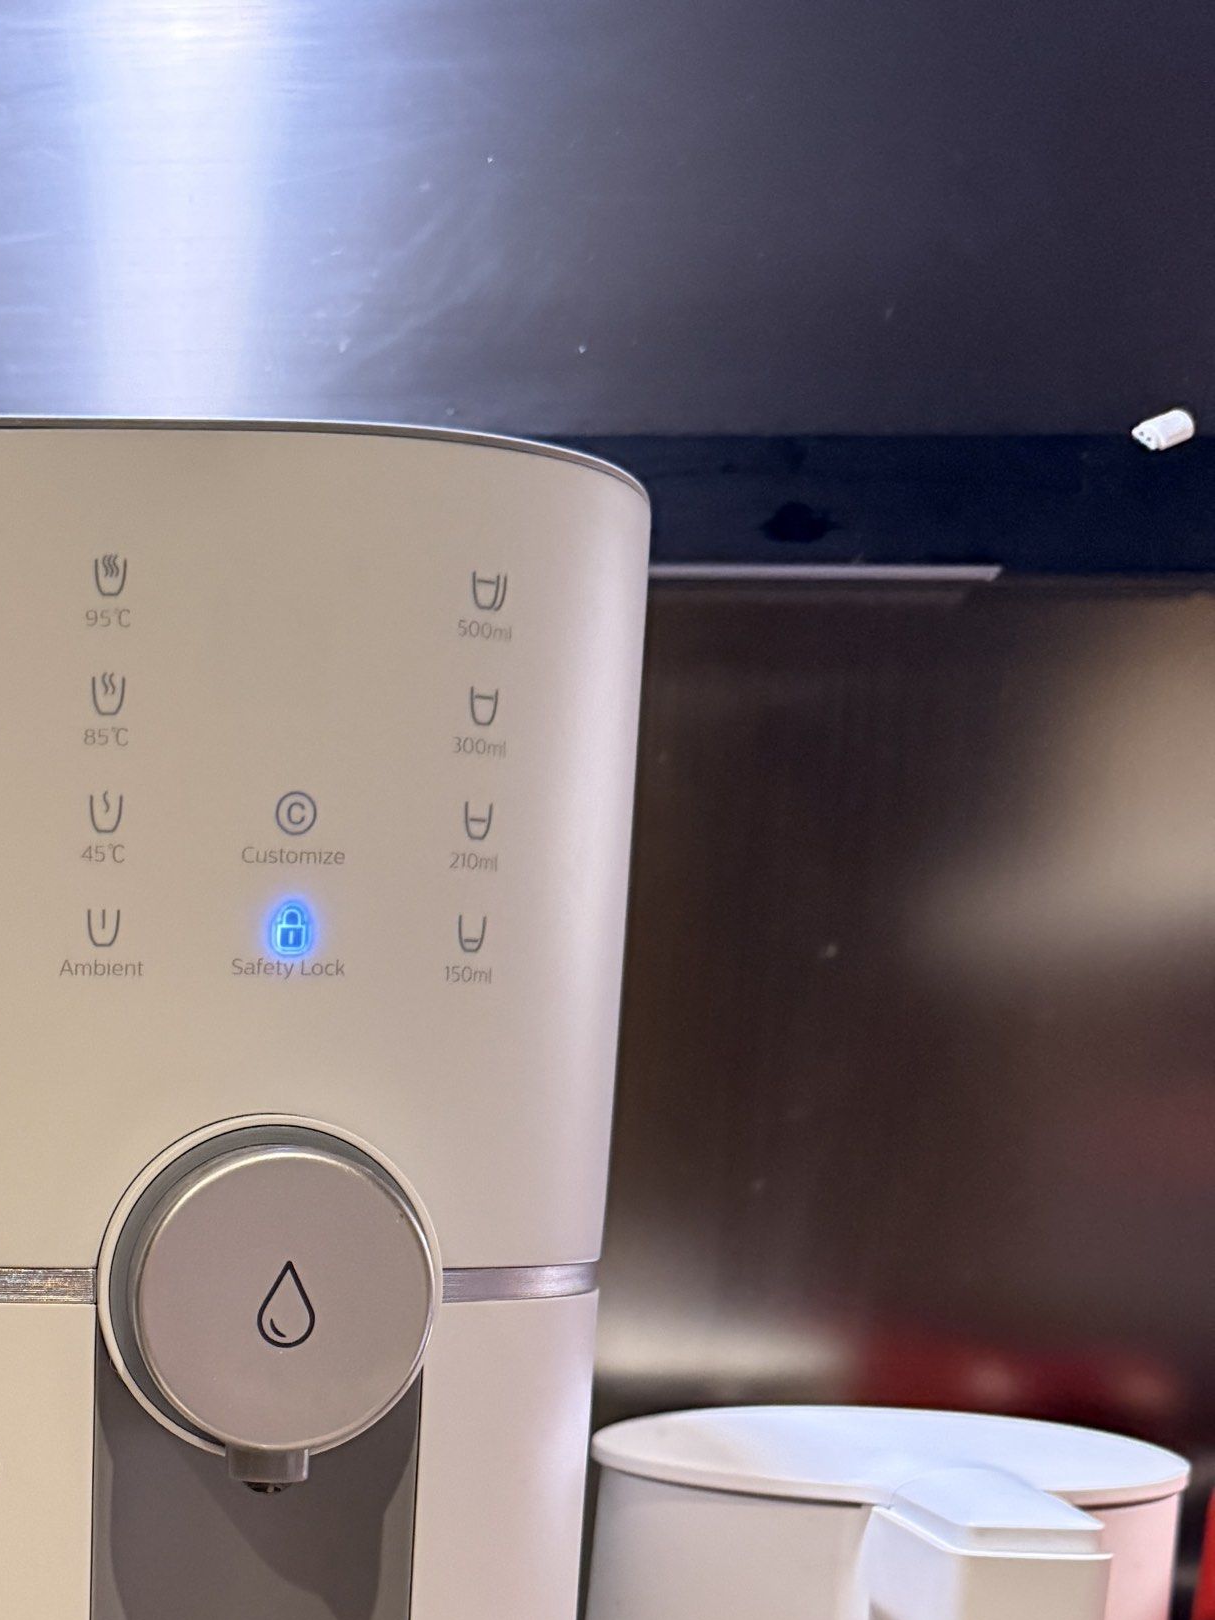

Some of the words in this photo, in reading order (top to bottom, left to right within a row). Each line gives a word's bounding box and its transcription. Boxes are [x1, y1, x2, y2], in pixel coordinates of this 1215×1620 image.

[457, 619, 513, 642] 500ml
[452, 736, 507, 758] 300ml
[241, 845, 346, 866] Customize
[449, 852, 499, 872] 210ml
[59, 957, 144, 978] Ambient
[231, 957, 295, 981] Safety
[300, 958, 346, 978] Lock
[444, 965, 493, 985] 150ml
